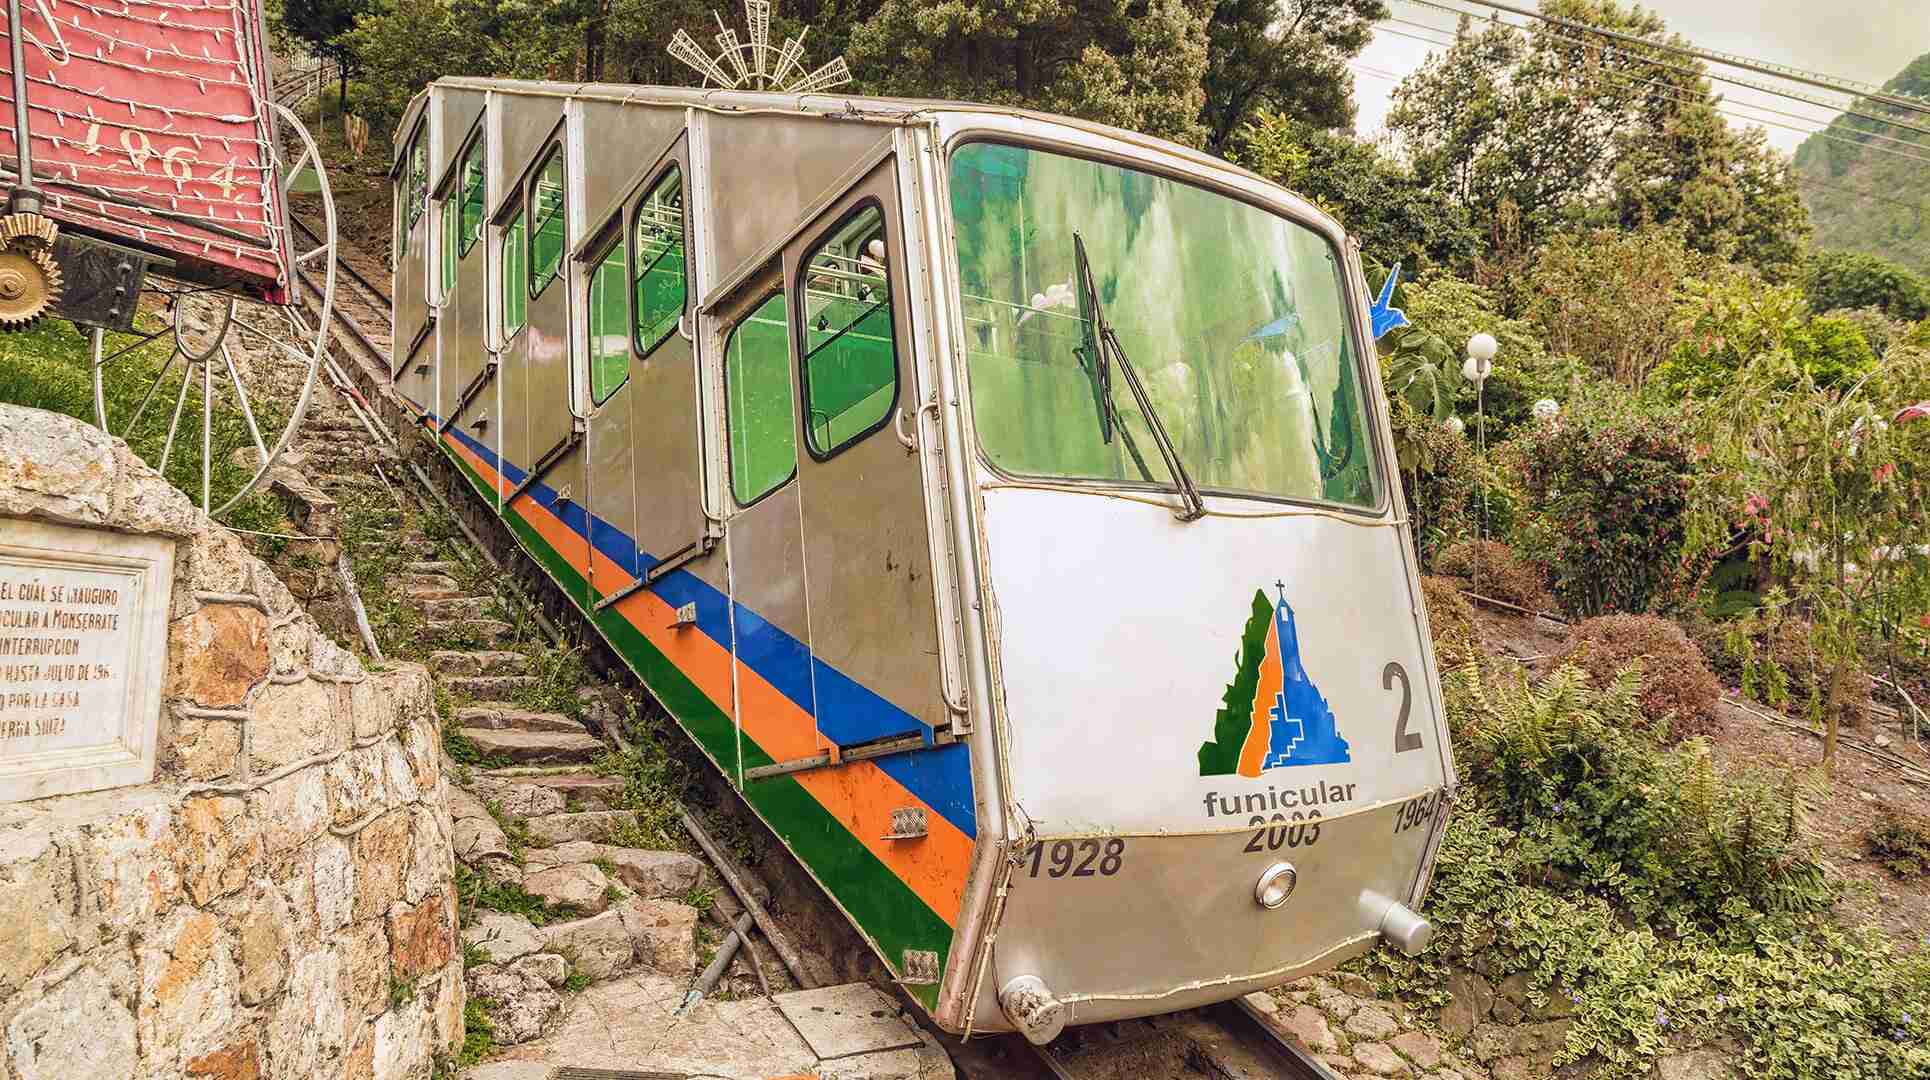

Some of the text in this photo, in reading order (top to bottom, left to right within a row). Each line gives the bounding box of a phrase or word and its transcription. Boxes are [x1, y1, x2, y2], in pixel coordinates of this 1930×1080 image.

[81, 118, 236, 199] 1964
[1, 582, 14, 600] EL
[50, 586, 64, 603] SE
[0, 609, 40, 630] CULAR
[42, 612, 48, 629] A
[6, 664, 39, 682] HASTA
[46, 664, 75, 681] JULIO
[79, 664, 89, 680] DE
[9, 692, 31, 709] POR
[34, 692, 48, 708] LA
[1383, 662, 1423, 753] 2
[1203, 780, 1356, 817] funicular
[1394, 792, 1437, 833] 1964
[1243, 809, 1322, 853] 2003
[1024, 839, 1125, 878] 1928
